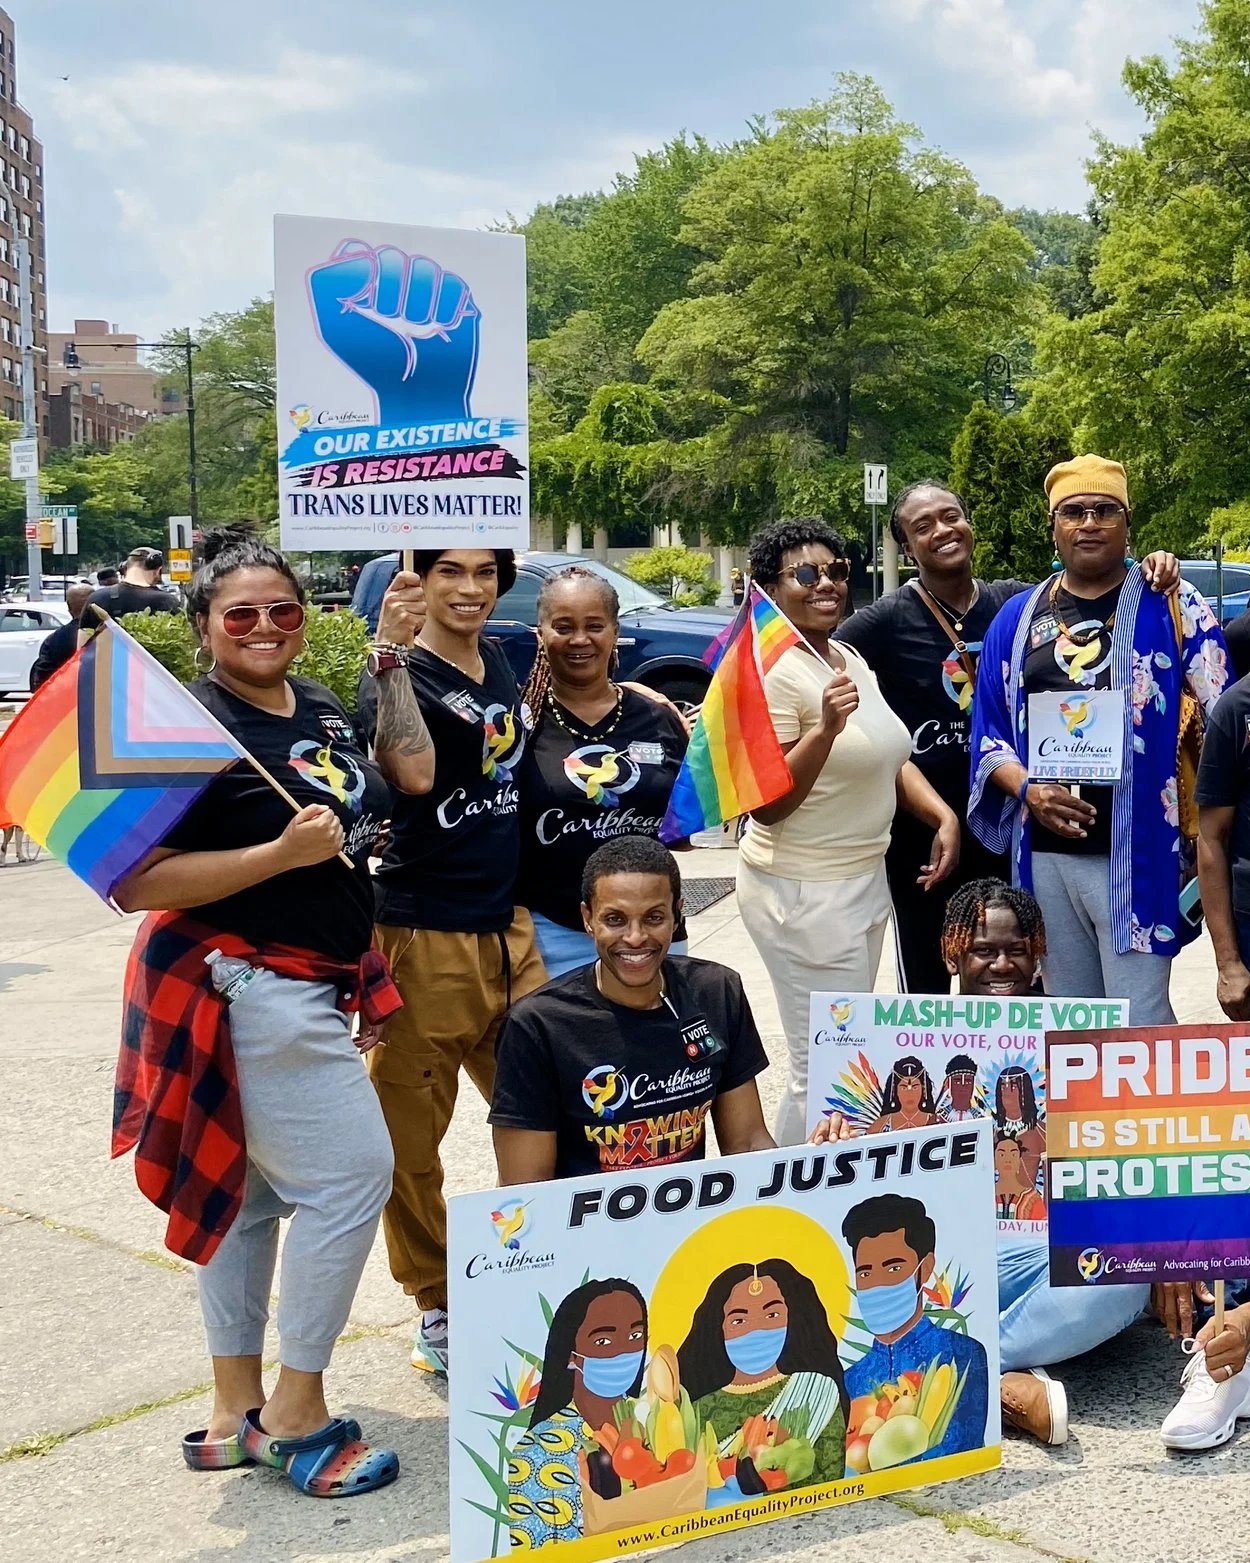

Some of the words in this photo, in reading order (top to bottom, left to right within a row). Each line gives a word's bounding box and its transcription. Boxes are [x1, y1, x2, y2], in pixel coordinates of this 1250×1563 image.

[314, 432, 370, 456] OUR
[375, 419, 503, 449] EXISTENCE
[310, 464, 340, 488] IS
[343, 451, 506, 485] RESISTANCE
[43, 508, 69, 517] OCEAN
[288, 493, 365, 516] TRANS
[370, 494, 429, 516] LIVES
[434, 495, 522, 516] MATTER!
[454, 693, 475, 709] VOTE
[950, 721, 965, 729] THE
[1038, 736, 1112, 757] Caribbean
[593, 826, 631, 839] EQUALITY
[874, 999, 1001, 1029] MASH-UP
[1008, 1001, 1043, 1029] DE
[1049, 1003, 1122, 1030] VOTE
[688, 1024, 710, 1041] VOTE
[895, 1032, 935, 1048] OUR
[941, 1033, 992, 1050] VOTE,
[997, 1034, 1037, 1050] OUR
[630, 1067, 711, 1100] Caribbean
[665, 1082, 692, 1094] EQUALITY
[1068, 1120, 1105, 1148] IS
[1114, 1117, 1221, 1146] STILL
[567, 1170, 737, 1231] FOOD
[756, 1132, 980, 1201] JUSTICE
[465, 1250, 555, 1279] Caribbean
[502, 1265, 530, 1275] EQUALITY
[531, 1261, 555, 1269] PROJECT
[1104, 1255, 1156, 1273] Caribbean
[1163, 1258, 1209, 1271] Advocating
[1210, 1257, 1222, 1269] for
[617, 1481, 865, 1548] www.CaribbeanEqualityProject.org
